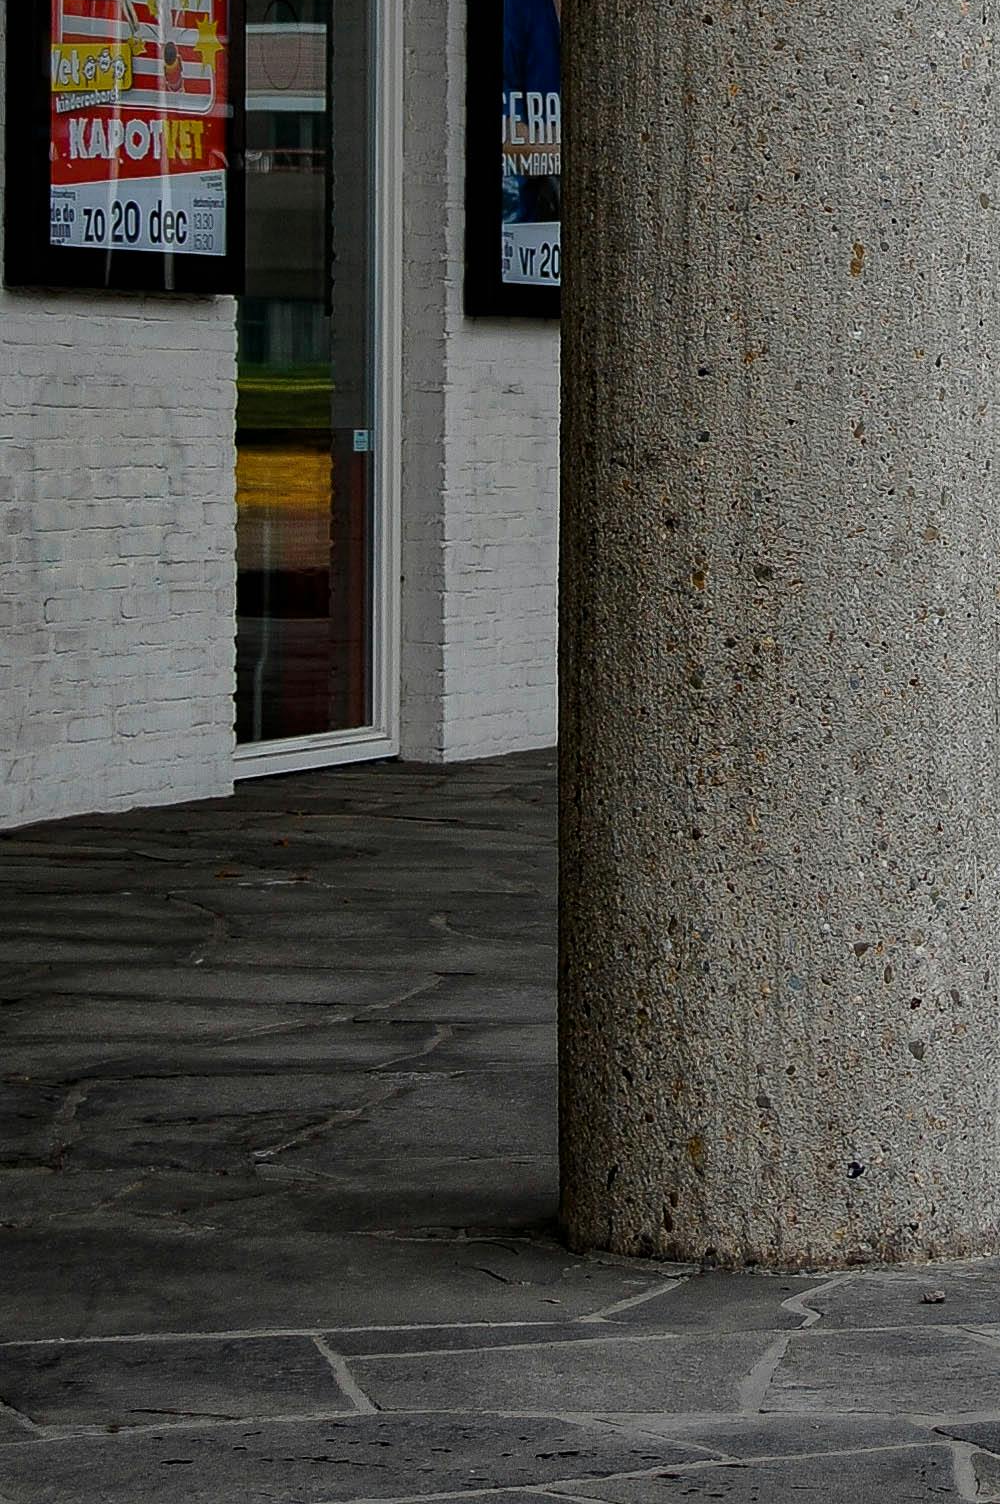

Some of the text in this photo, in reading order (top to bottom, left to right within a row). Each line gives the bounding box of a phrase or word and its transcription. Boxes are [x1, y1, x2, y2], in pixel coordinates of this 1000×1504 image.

[83, 200, 187, 244] zo 20 dec
[519, 247, 536, 276] vr
[540, 242, 561, 279] 20
